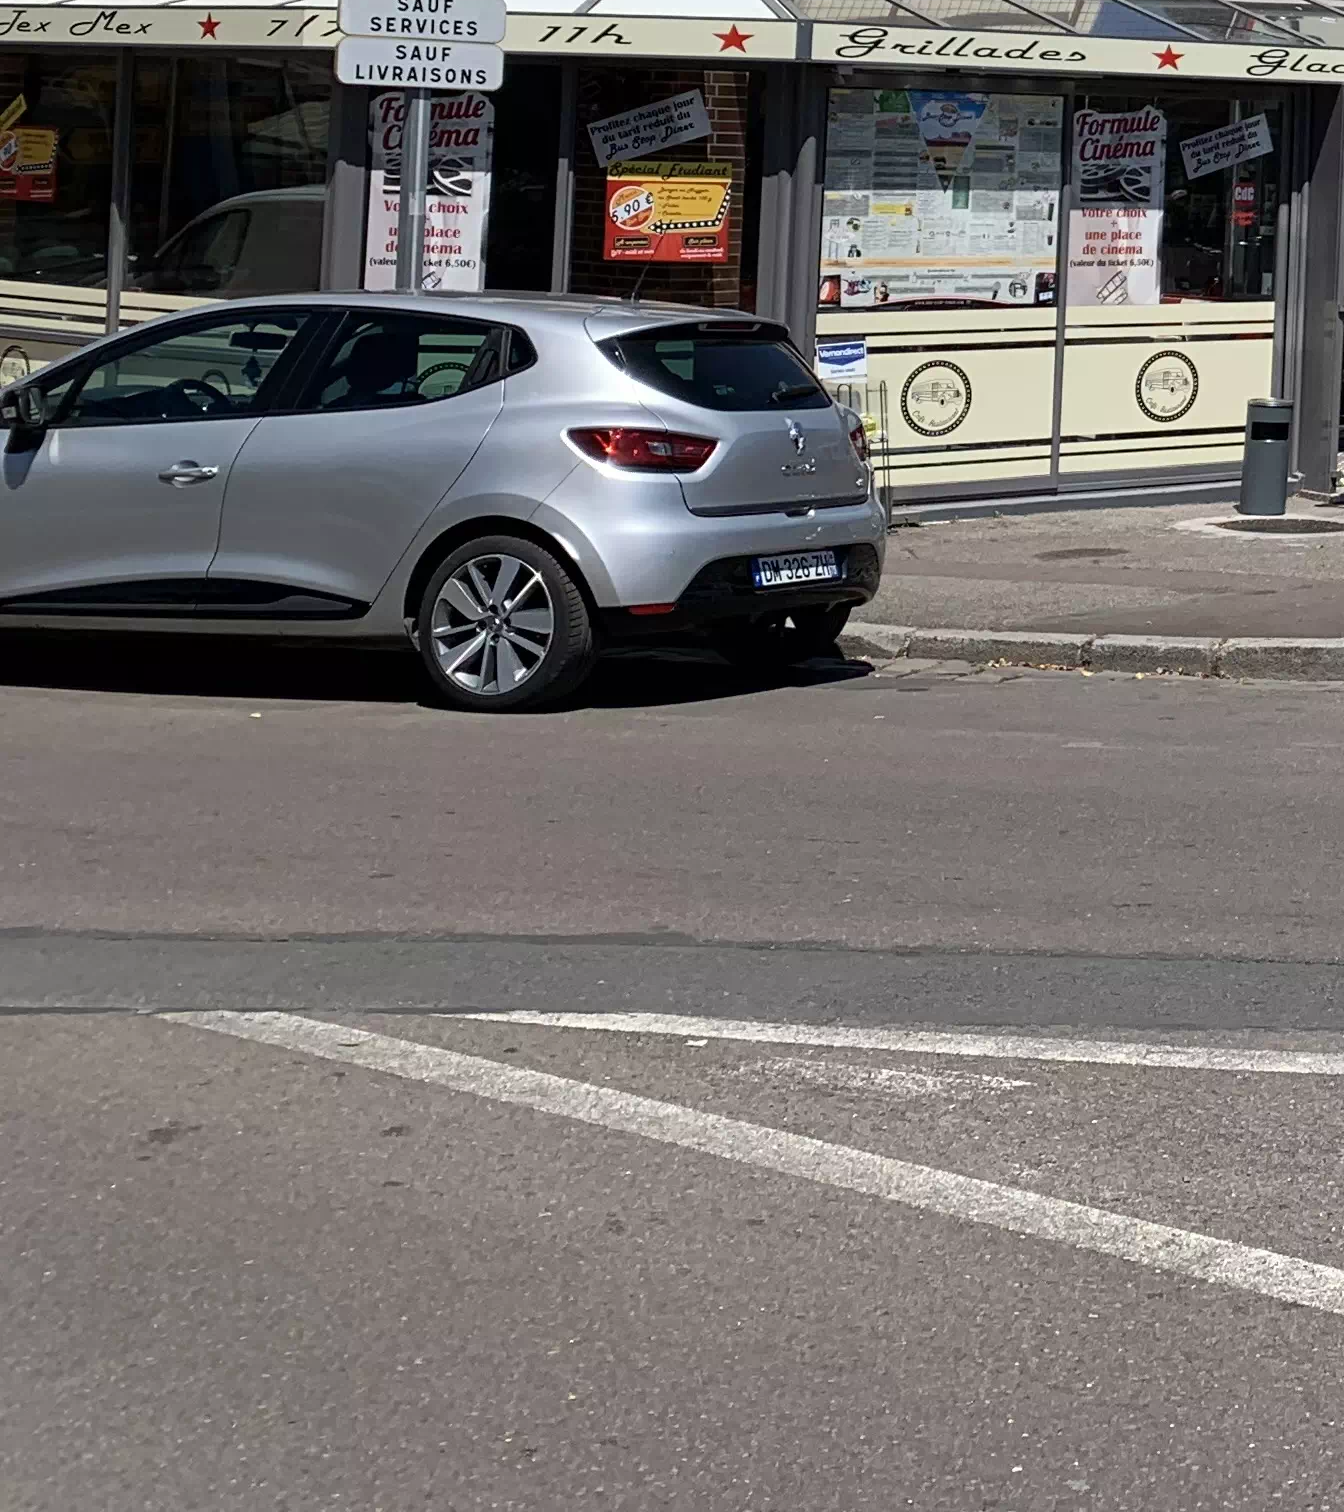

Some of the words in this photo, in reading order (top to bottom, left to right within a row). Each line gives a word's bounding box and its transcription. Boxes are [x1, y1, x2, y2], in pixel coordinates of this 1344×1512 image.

[69, 10, 152, 35] Mex
[370, 16, 478, 36] SERVICES
[396, 45, 452, 62] SAUF
[835, 27, 1086, 62] Grillades
[355, 64, 487, 84] LIVRAISONS
[379, 94, 487, 124] Fomule
[590, 117, 631, 136] Profitez
[633, 104, 671, 122] chaque
[673, 96, 695, 112] jour
[601, 133, 615, 145] du
[618, 125, 642, 140] tarif
[676, 110, 691, 122] du
[1076, 110, 1160, 138] Formule
[605, 143, 629, 161] Bus
[631, 134, 656, 149] Stop
[661, 122, 695, 143] Diner
[1079, 135, 1156, 162] Cinéma
[429, 201, 469, 215] choix
[1081, 208, 1112, 218] Votre
[1116, 208, 1147, 218] choix
[1084, 231, 1107, 240] une
[1111, 229, 1142, 242] place
[1082, 244, 1096, 255] de
[1100, 243, 1143, 255] cinéma
